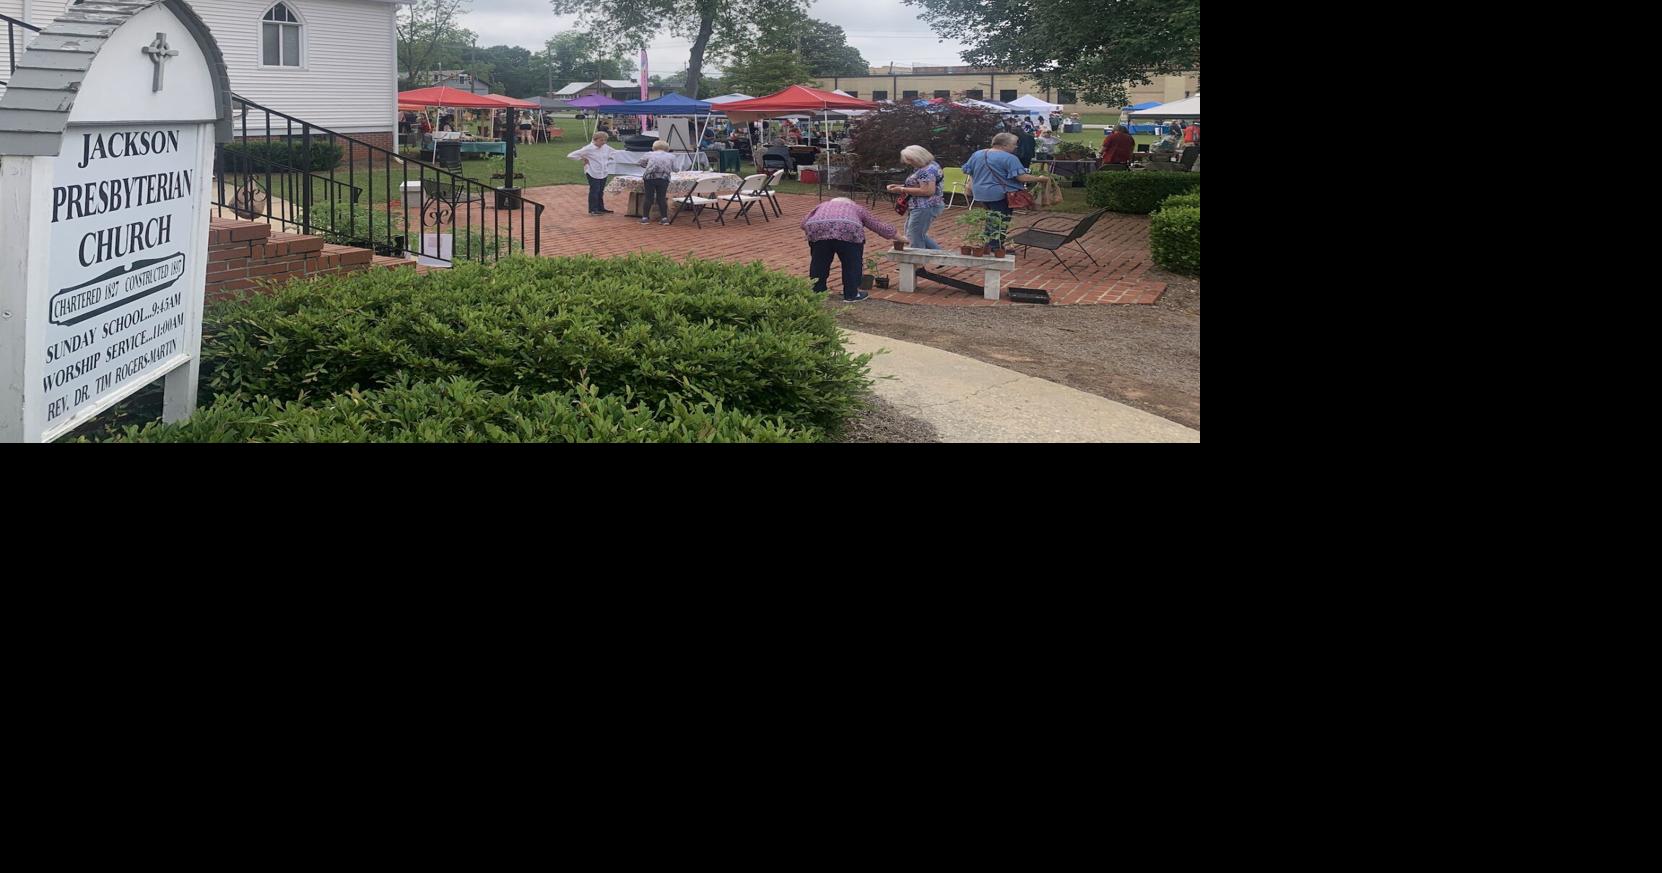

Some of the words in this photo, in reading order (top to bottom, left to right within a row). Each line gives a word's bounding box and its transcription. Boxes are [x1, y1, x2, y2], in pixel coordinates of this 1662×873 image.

[78, 130, 180, 169] JACKSON
[51, 169, 193, 223] PRESBYTERIAN
[78, 214, 172, 267] CHURCH
[54, 287, 101, 318] CHARTERED
[105, 280, 119, 301] 1827
[125, 264, 169, 292] CONSTRUCTED
[46, 326, 97, 364] SUNDAY
[42, 352, 101, 393] WORSHIP
[48, 394, 69, 422] REV.
[74, 384, 90, 407] DR.
[95, 371, 112, 394] TIM
